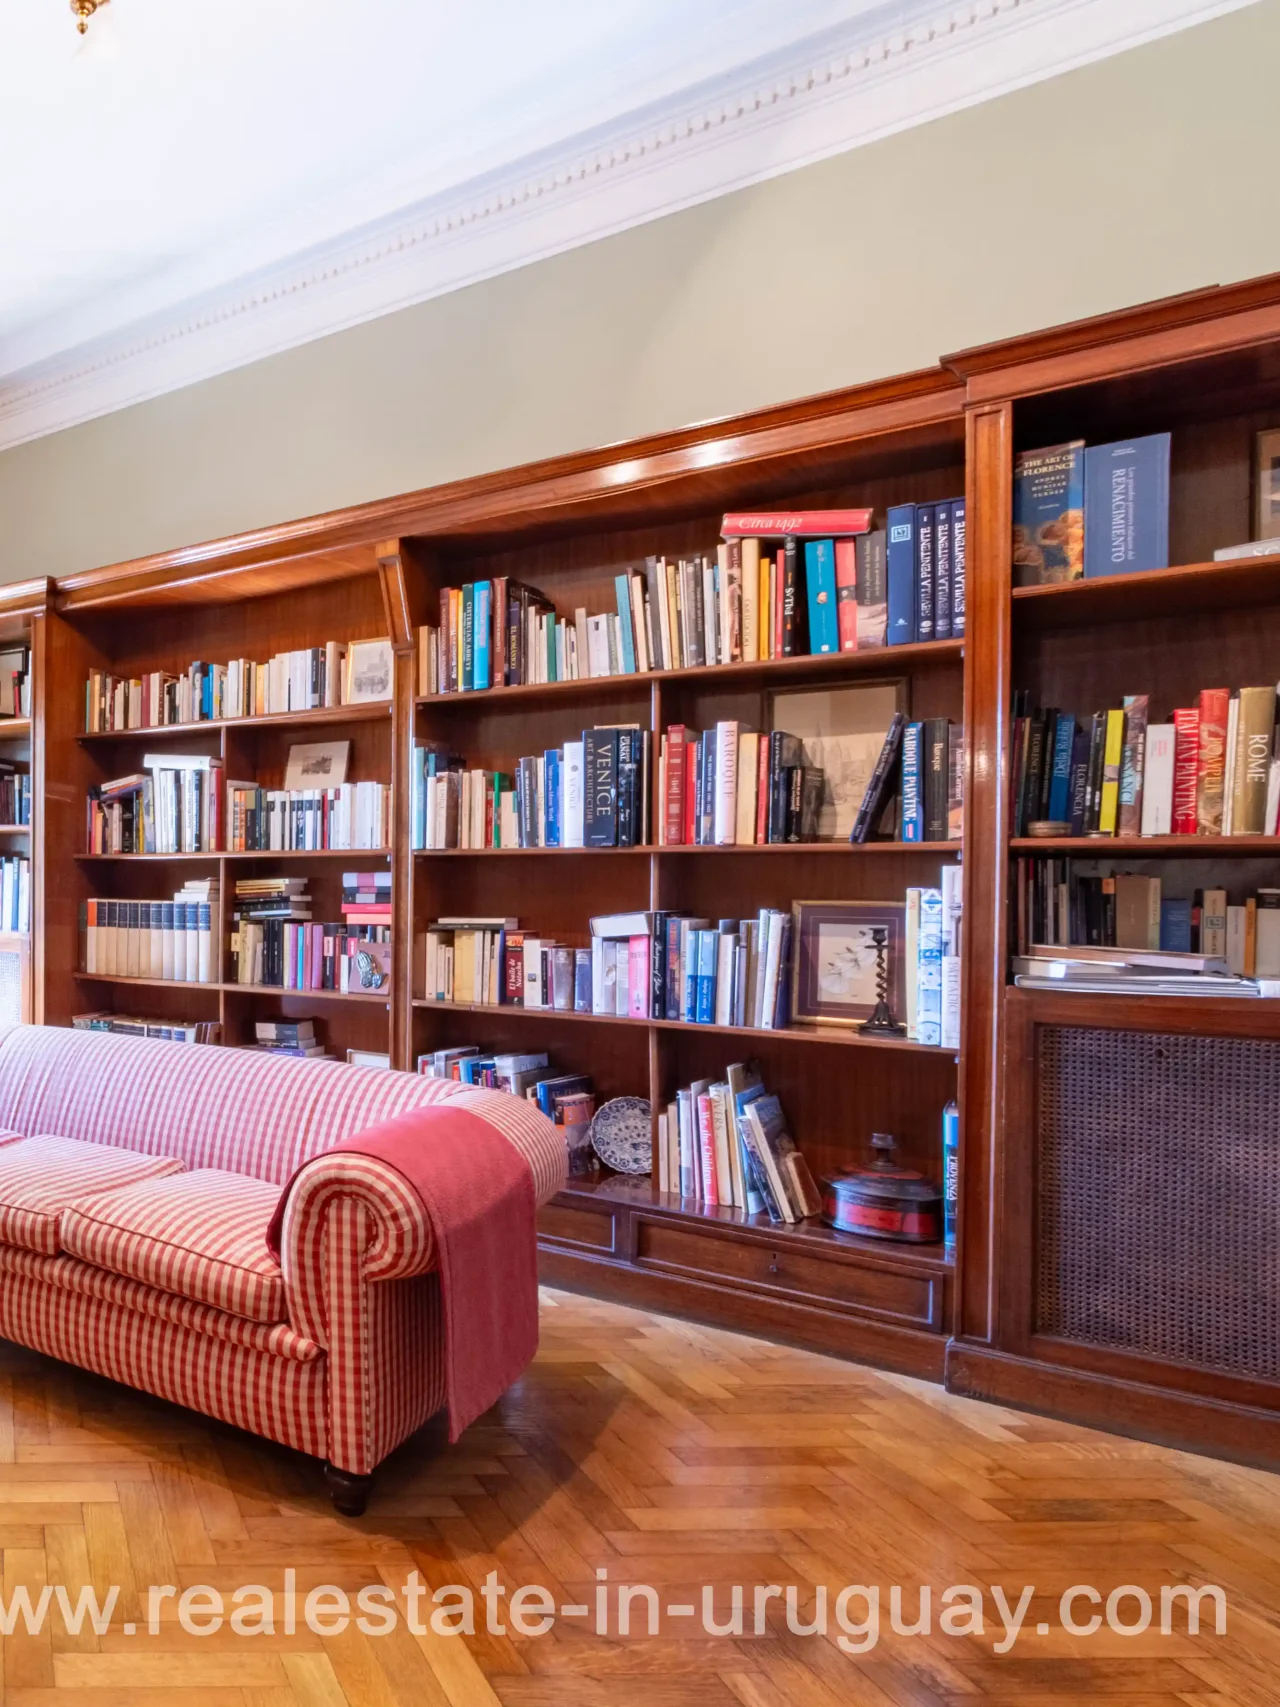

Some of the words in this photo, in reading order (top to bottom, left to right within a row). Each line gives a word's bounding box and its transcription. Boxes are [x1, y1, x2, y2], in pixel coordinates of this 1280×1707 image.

[1023, 459, 1042, 468] THE
[1044, 455, 1062, 465] ART
[1023, 460, 1076, 477] FLORENCE
[739, 516, 772, 529] Circa
[775, 517, 803, 532] 1492
[1111, 468, 1126, 563] RENACIMIENTO
[920, 526, 932, 578] PENITENTE
[937, 523, 949, 576] PENITENTE
[954, 520, 966, 573] PENITENTE
[783, 587, 794, 616] FALLAS
[920, 580, 932, 617] SEVILLA
[937, 577, 949, 616] SEVILLA
[954, 573, 965, 613] SEVILLA
[510, 625, 517, 635] EL
[586, 738, 594, 752] ART
[902, 727, 917, 774] BAROQUE
[1056, 721, 1072, 750] Robbia
[1177, 709, 1199, 760] ITALIAN
[721, 729, 735, 800] BAROQUE
[931, 742, 944, 772] Baroque
[1246, 733, 1269, 783] ROME
[586, 764, 594, 825] ARCHITECTURE
[596, 744, 612, 816] VENICE
[902, 776, 917, 822] PAINTING
[1072, 763, 1087, 816] FLORENCIA
[1174, 761, 1198, 820] PAINTING
[508, 958, 515, 967] de
[508, 967, 516, 983] baile
[515, 961, 523, 988] Natacha
[509, 982, 516, 991] El
[947, 961, 960, 1014] PALLADIO
[702, 1129, 711, 1143] the
[703, 1145, 713, 1185] Children
[949, 1155, 958, 1201] PROVENZA
